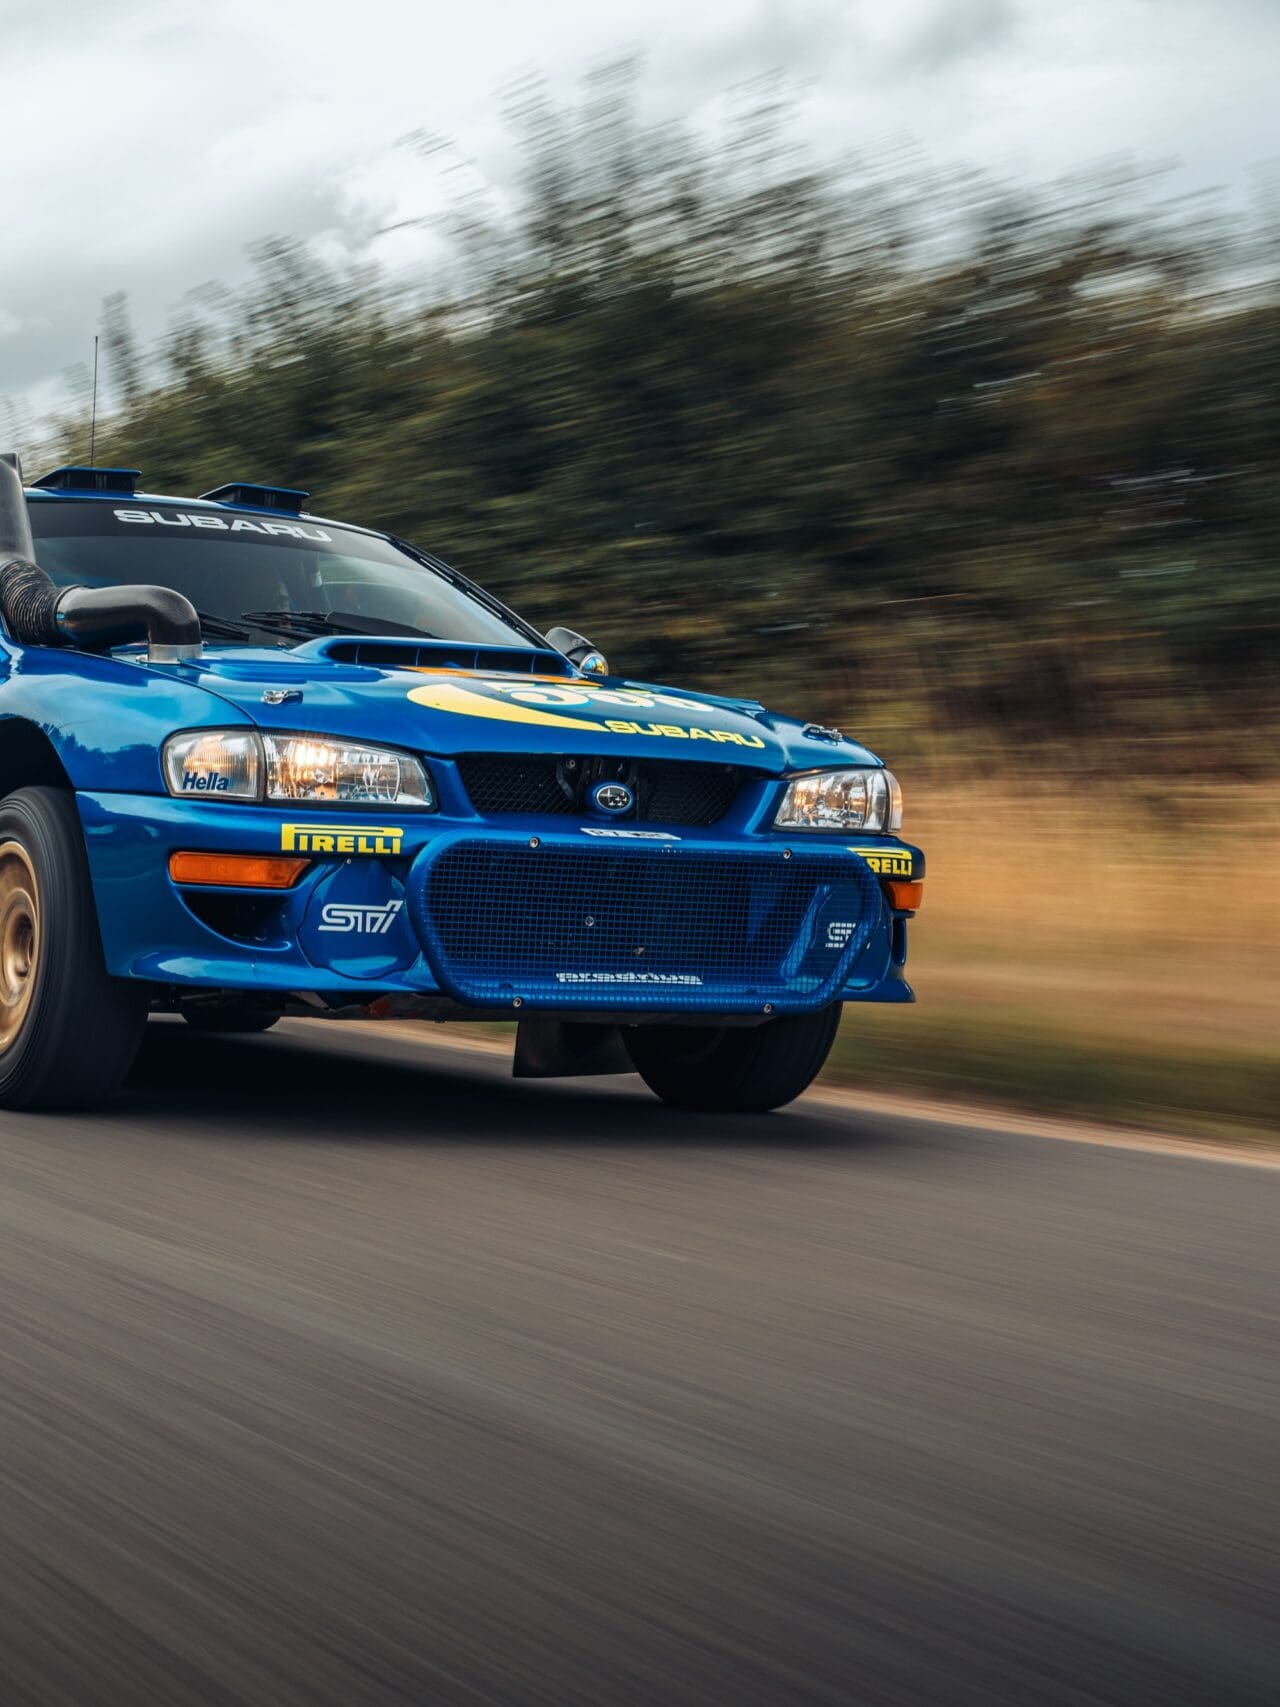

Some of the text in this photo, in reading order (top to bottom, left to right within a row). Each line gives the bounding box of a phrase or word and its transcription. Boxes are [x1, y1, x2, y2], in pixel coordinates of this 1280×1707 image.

[113, 509, 332, 542] SUBARU
[604, 719, 765, 748] SUBARU
[182, 772, 229, 791] Hella
[281, 823, 404, 855] PIRELLI
